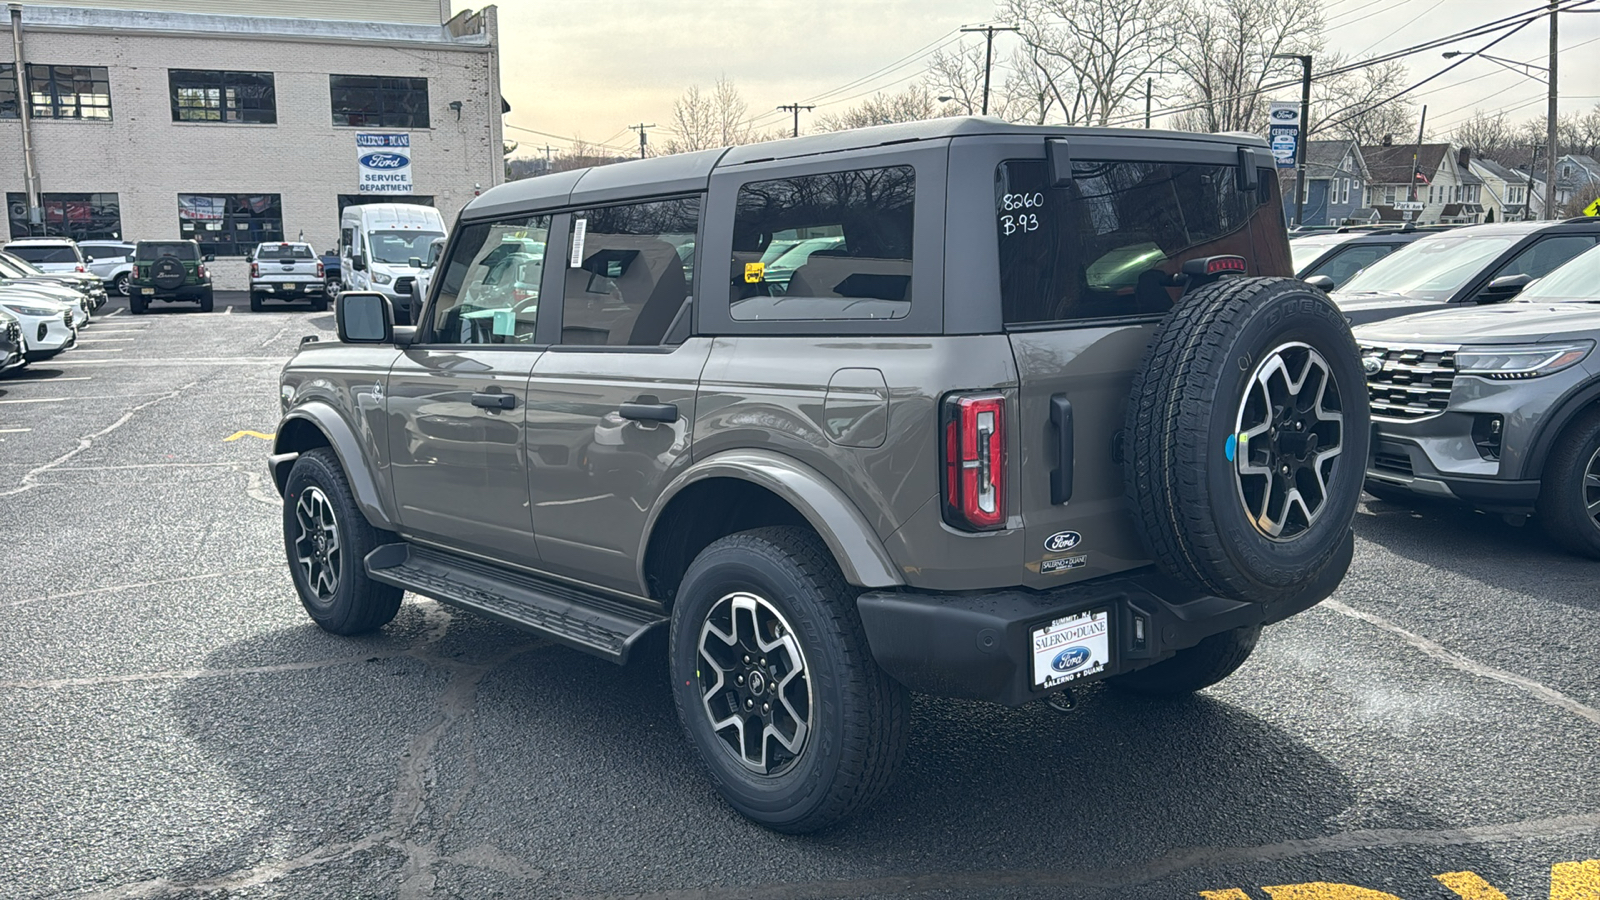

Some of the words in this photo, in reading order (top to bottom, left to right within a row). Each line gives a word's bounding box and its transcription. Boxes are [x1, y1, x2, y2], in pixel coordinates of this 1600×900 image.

[1276, 110, 1294, 119] Ford
[1271, 128, 1298, 136] CERTIFIED
[357, 135, 384, 146] SALERNO
[389, 135, 409, 146] DUANE
[369, 154, 401, 167] Ford
[364, 174, 407, 182] SERVICE
[360, 184, 413, 192] DEPARTMENT
[1003, 192, 1044, 211] 8260
[1396, 202, 1410, 210] Park
[1042, 559, 1065, 569] SALERNO
[1068, 556, 1086, 565] DUANE
[1081, 610, 1091, 619] NJ
[1035, 630, 1073, 651] SALERNO
[1076, 620, 1106, 638] DUANE
[1058, 650, 1084, 669] Ford
[1043, 674, 1075, 689] SALERNO
[1083, 664, 1105, 677] DUANE
